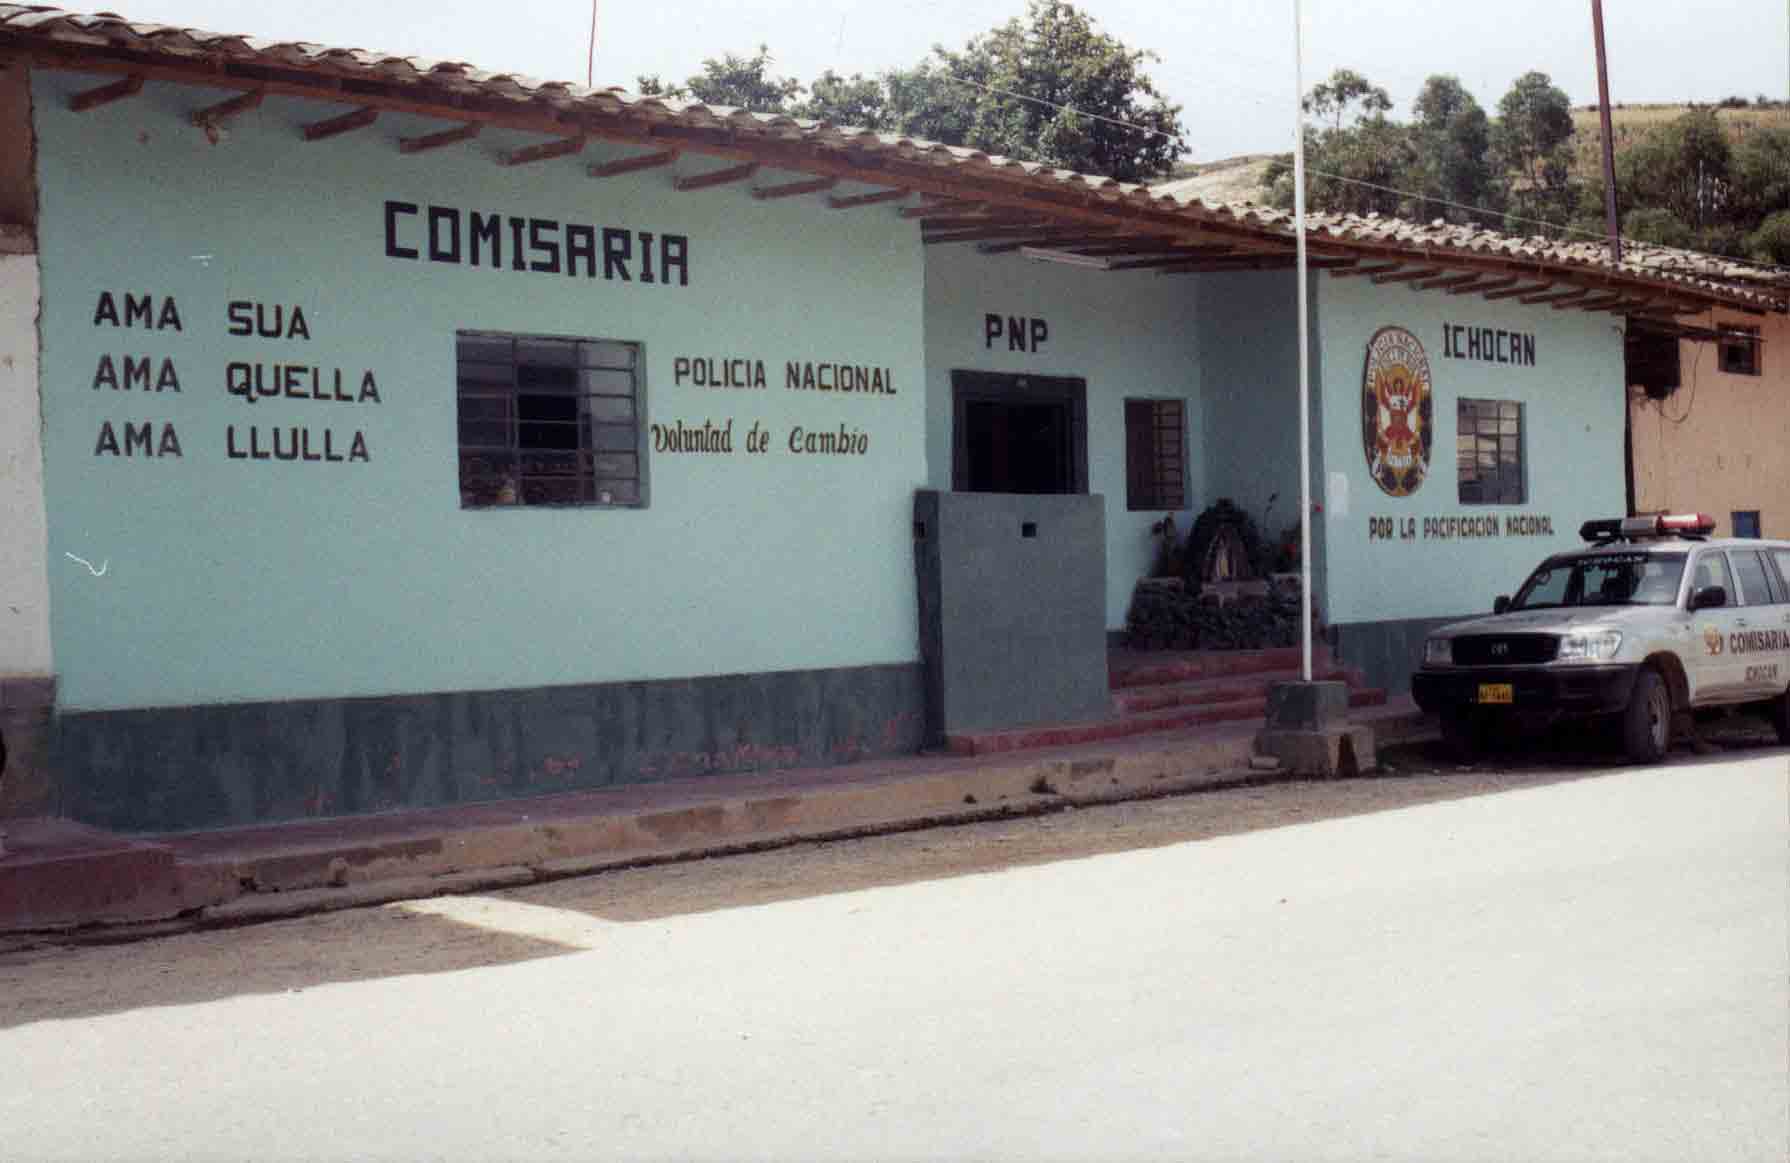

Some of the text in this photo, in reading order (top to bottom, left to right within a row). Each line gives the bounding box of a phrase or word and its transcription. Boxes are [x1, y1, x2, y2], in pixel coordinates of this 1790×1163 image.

[385, 200, 688, 286] COMISARIA
[94, 291, 310, 340] AMA SUA
[985, 313, 1049, 353] PNP
[1443, 321, 1536, 367] ICHOCAN
[93, 354, 381, 404] AMA QUELLA
[675, 358, 897, 395] POLICIA NACIONAL
[96, 422, 369, 462] AMA LLULLA
[651, 418, 869, 455] Voluntad de Cambio
[1369, 517, 1393, 540] POR
[1400, 517, 1416, 540] LA
[1506, 515, 1555, 537] NACIONAL
[1729, 630, 1790, 655] COMISARIA
